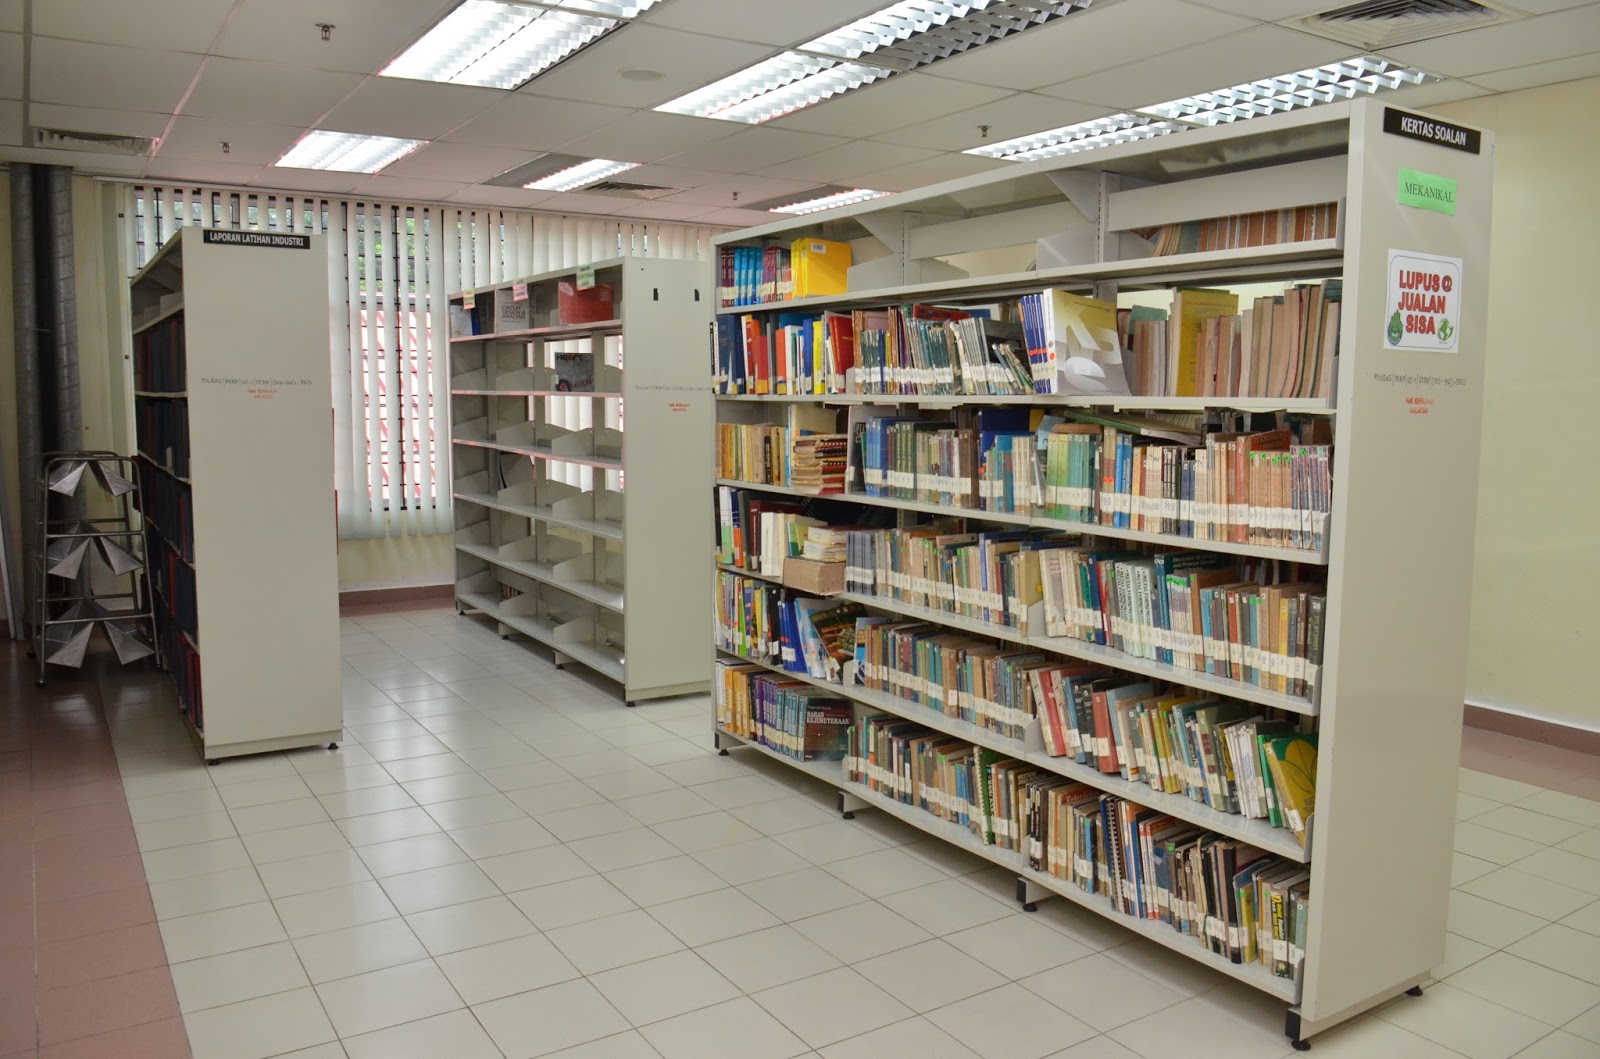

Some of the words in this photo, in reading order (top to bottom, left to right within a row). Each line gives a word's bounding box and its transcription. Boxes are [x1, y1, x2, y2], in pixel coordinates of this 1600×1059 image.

[1401, 116, 1434, 138] KERTAS
[1435, 125, 1467, 146] SOALAN
[1404, 182, 1454, 203] MEKANIKAL
[209, 232, 241, 242] LAPORAN
[242, 234, 271, 244] LATIHAN
[272, 236, 304, 246] INDUSTRI
[1399, 269, 1440, 292] LUPUS
[1398, 291, 1446, 314] JUALAN
[1405, 314, 1436, 335] SISA
